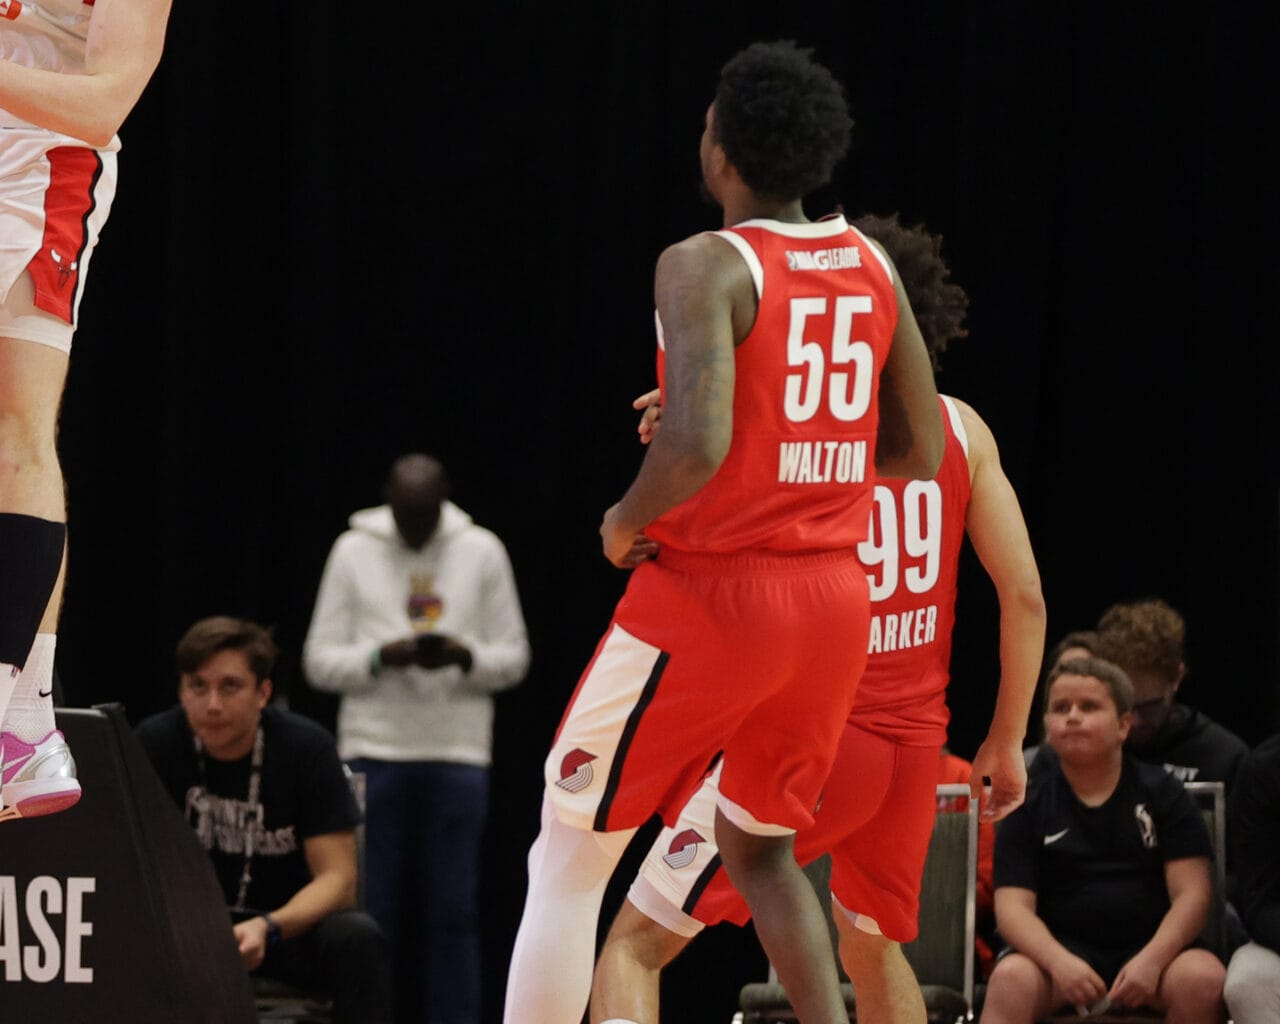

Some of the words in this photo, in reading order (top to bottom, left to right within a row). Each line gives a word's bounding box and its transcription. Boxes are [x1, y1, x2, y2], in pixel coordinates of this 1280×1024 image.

[783, 295, 874, 423] 55
[778, 440, 867, 484] WALTON
[857, 479, 943, 602] 99
[867, 605, 938, 655] ARKER
